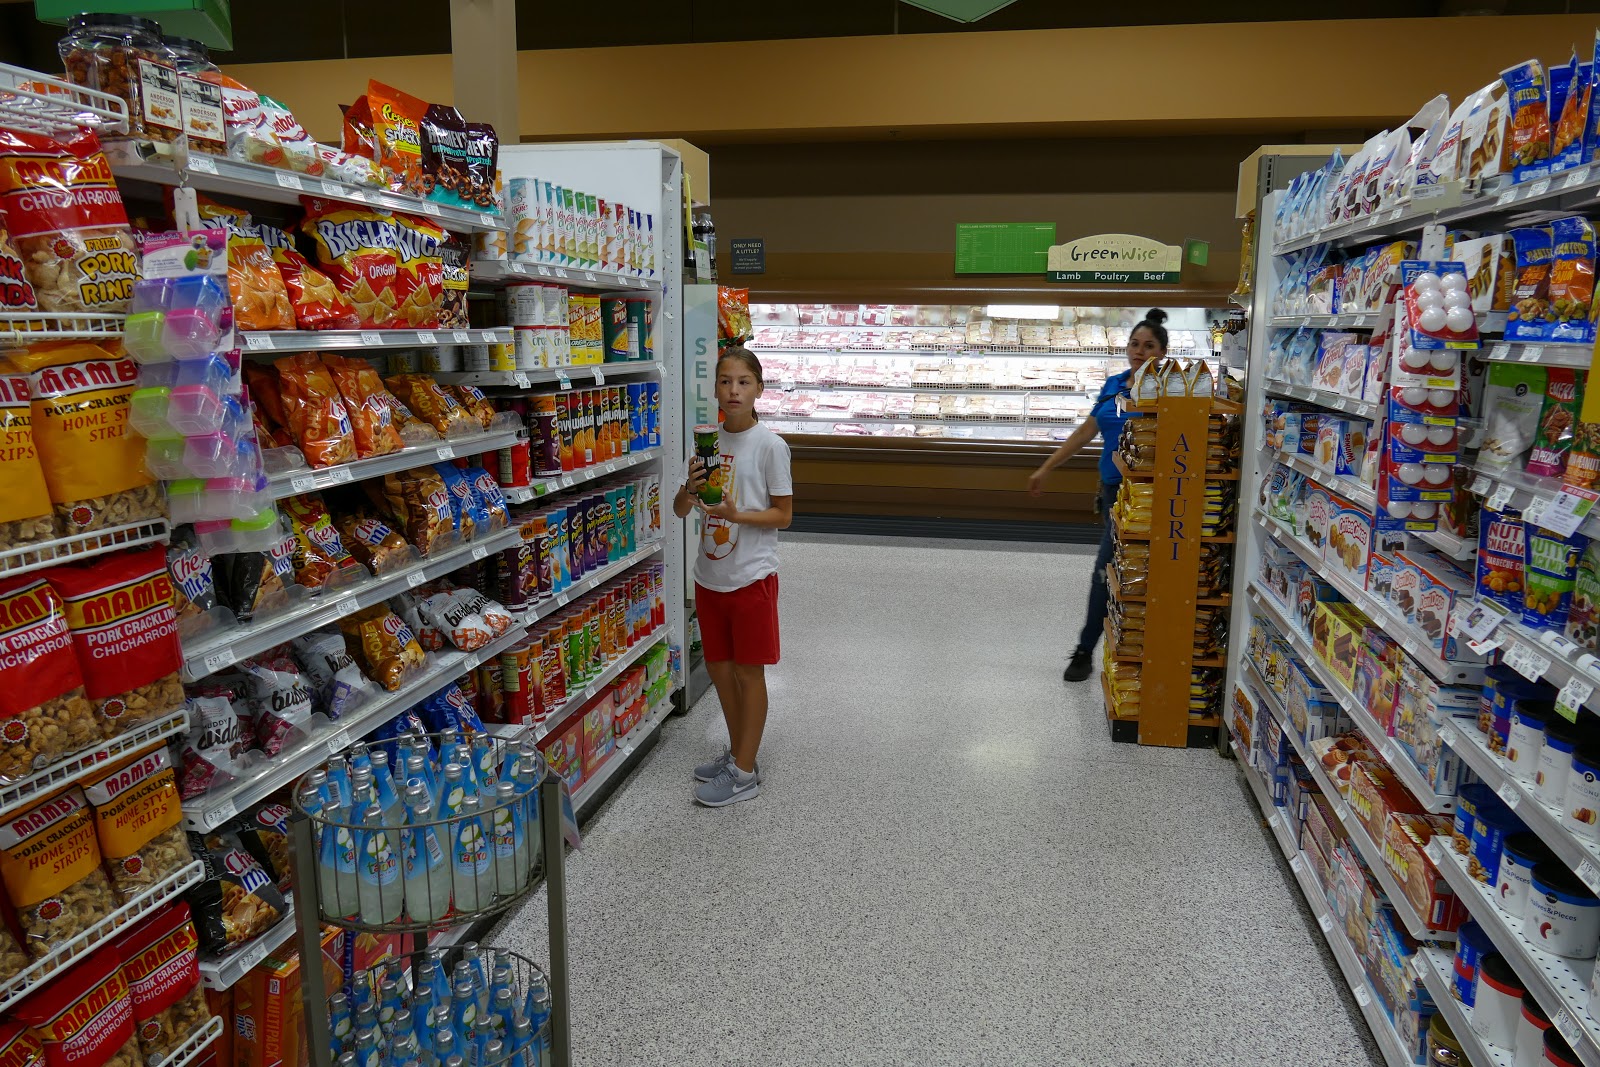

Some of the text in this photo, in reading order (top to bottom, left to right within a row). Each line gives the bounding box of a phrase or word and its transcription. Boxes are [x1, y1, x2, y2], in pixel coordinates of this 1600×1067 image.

[150, 93, 175, 104] ANDERSON
[1514, 88, 1539, 101] NTERS
[190, 107, 217, 118] ANDERSON
[1518, 106, 1531, 115] ICY
[385, 128, 421, 146] SNACK
[467, 139, 492, 158] HEY'S
[15, 156, 112, 185] MAMB
[20, 191, 123, 212] CHICHARRON
[84, 238, 122, 251] FRIED
[396, 221, 442, 264] BUG
[1070, 245, 1158, 262] GreenWise
[0, 255, 24, 282] RK
[79, 251, 137, 281] PORK
[369, 263, 397, 280] ORIGIN
[1056, 271, 1166, 282] Lamb Poultry Beef
[81, 277, 136, 306] RIND
[568, 306, 584, 325] PIK-N
[585, 307, 600, 325] PIK-N
[39, 359, 138, 395] MAMB
[1549, 382, 1575, 399] EMERA
[43, 393, 131, 418] PORK CRACK
[306, 394, 321, 440] CHED
[366, 394, 388, 413] Che
[63, 411, 108, 432] HOME
[89, 427, 124, 443] STRI
[557, 420, 572, 432] AVY
[5, 430, 32, 445] STY
[1344, 433, 1356, 465] Twinkies
[0, 446, 35, 462] RIPS
[1578, 455, 1600, 472] PEANUT
[428, 490, 449, 508] Che
[451, 479, 469, 498] Che
[1167, 432, 1190, 561] ASTURI
[305, 524, 337, 545] Chex
[354, 519, 381, 541] Che
[368, 523, 391, 546] mi
[1488, 521, 1524, 541] NUT
[0, 585, 63, 630] AMB
[82, 576, 173, 625] MAMB
[10, 618, 69, 650] CRACKLIN
[87, 609, 176, 647] PORK CRACKLIN
[383, 615, 403, 635] Che
[0, 633, 73, 671] ICHARRON
[92, 622, 178, 660] CHICHARRONE
[364, 620, 385, 661] HONE
[271, 684, 312, 712] budd
[446, 688, 463, 708] Che
[197, 717, 241, 751] budd
[105, 753, 164, 797] MAMBI
[101, 774, 176, 820] PORK CRACKLING
[115, 785, 177, 829] HOME STYLE
[1351, 788, 1372, 822] BUNS
[12, 794, 80, 837] MAMBI
[131, 803, 168, 833] STRIPS
[256, 804, 292, 826] Che
[13, 812, 93, 861] PORK CRACKLING
[29, 826, 95, 870] HOME STYLE
[53, 844, 91, 874] STRIPS
[225, 849, 257, 876] Che
[1386, 843, 1410, 883] BUNS
[242, 867, 271, 893] mi
[122, 928, 197, 980] MAMBI
[332, 932, 345, 953] 10
[130, 949, 198, 996] PORK CRACKLING
[133, 964, 193, 1005] CHICHARRO
[52, 969, 129, 1039] MAMBI
[61, 994, 132, 1052] PORK CRACKLINGS
[66, 1006, 134, 1063] CHICHARRONES
[245, 1013, 257, 1043] Chex
[265, 995, 280, 1061] MULTIPACK
